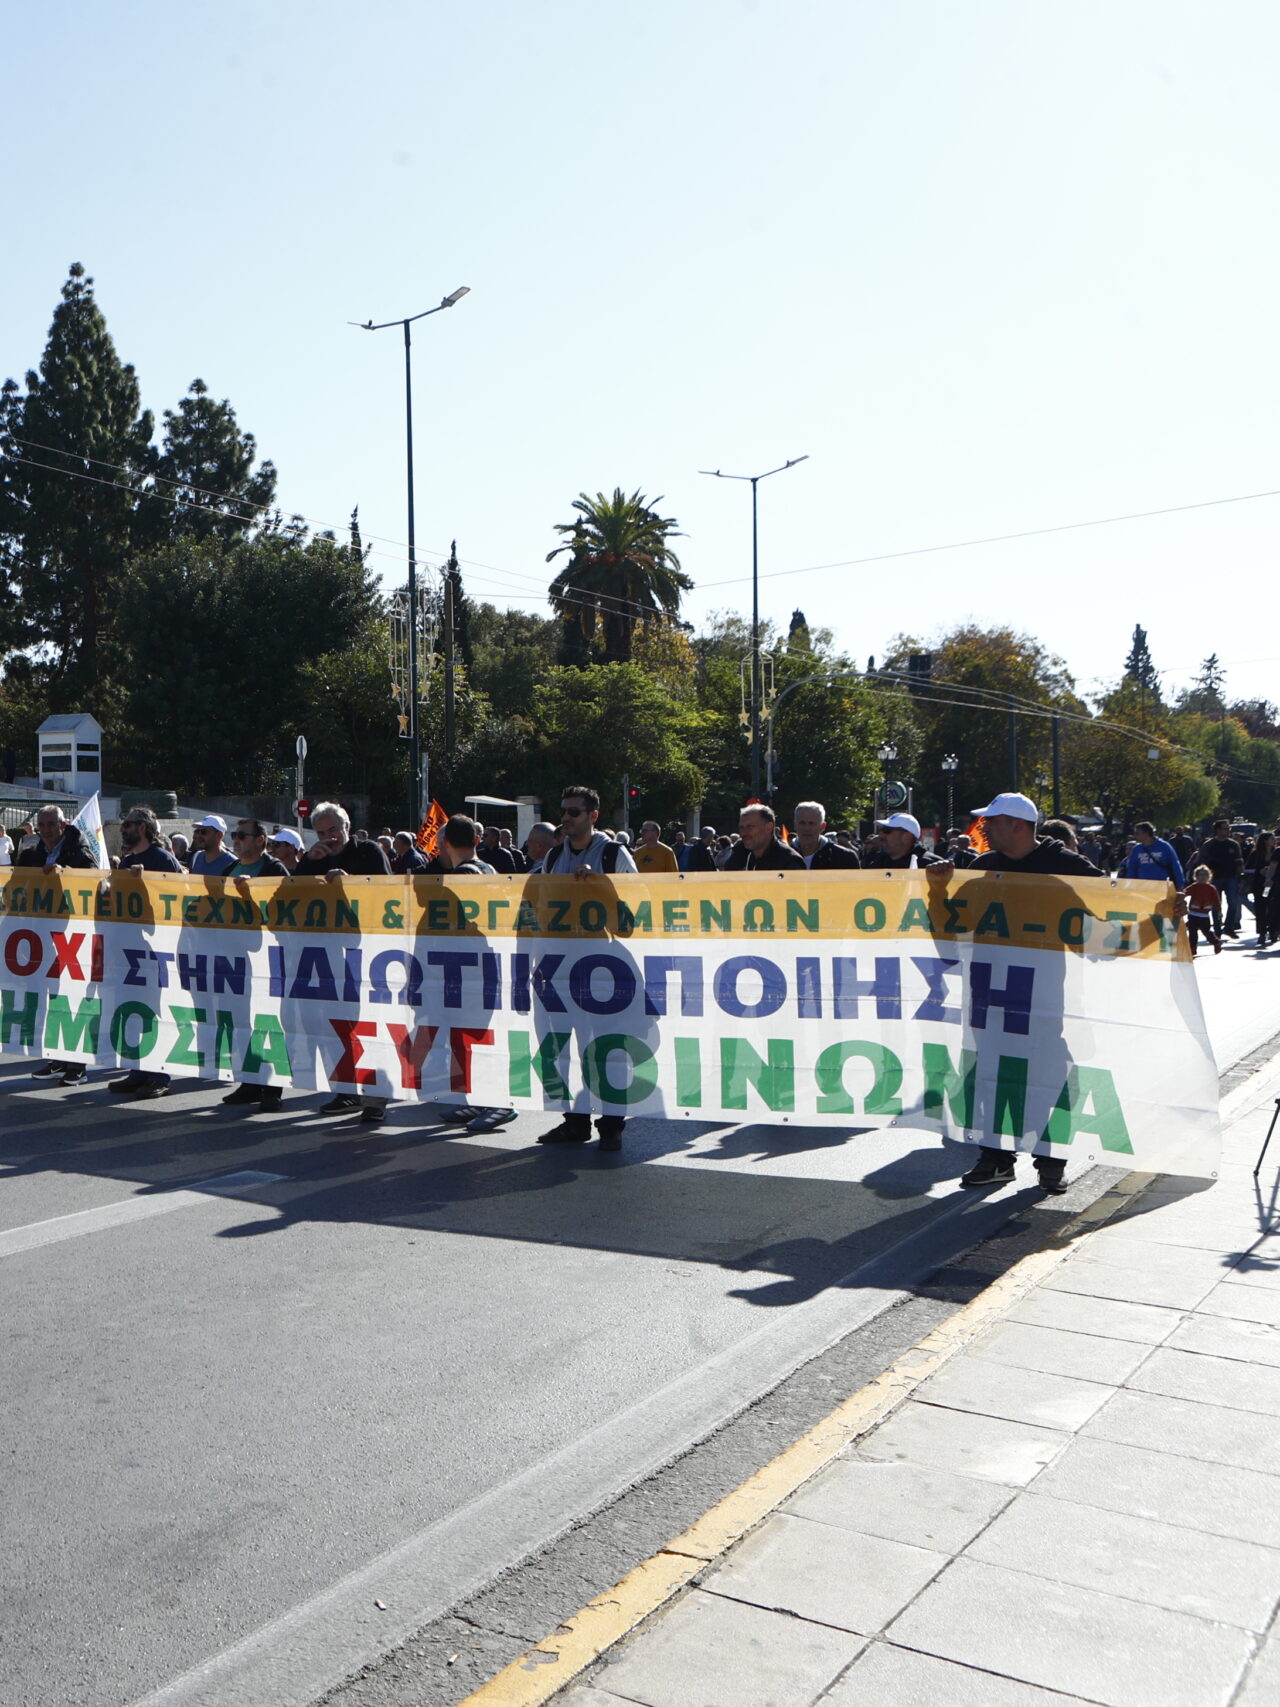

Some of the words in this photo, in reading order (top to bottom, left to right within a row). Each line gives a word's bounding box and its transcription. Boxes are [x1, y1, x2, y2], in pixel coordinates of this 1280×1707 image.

[159, 894, 360, 929] ΤΕΧΝΙΚΩΝ
[381, 899, 405, 930] &
[427, 898, 820, 932] ΕΡΓΑΖΟΜΕΝΩΝ
[853, 898, 1182, 952] ΟΑΣΑ-ΟΣΥ
[4, 928, 105, 983] ΟΧΙ
[122, 949, 247, 995] ΣΤΗΝ
[268, 945, 1035, 1036] ΙΔΙΩΤΙΚΟΠΟΙΗΣΗ
[328, 1018, 1135, 1156] ΣΥΓΚΟΙΝΩΝΙΑ
